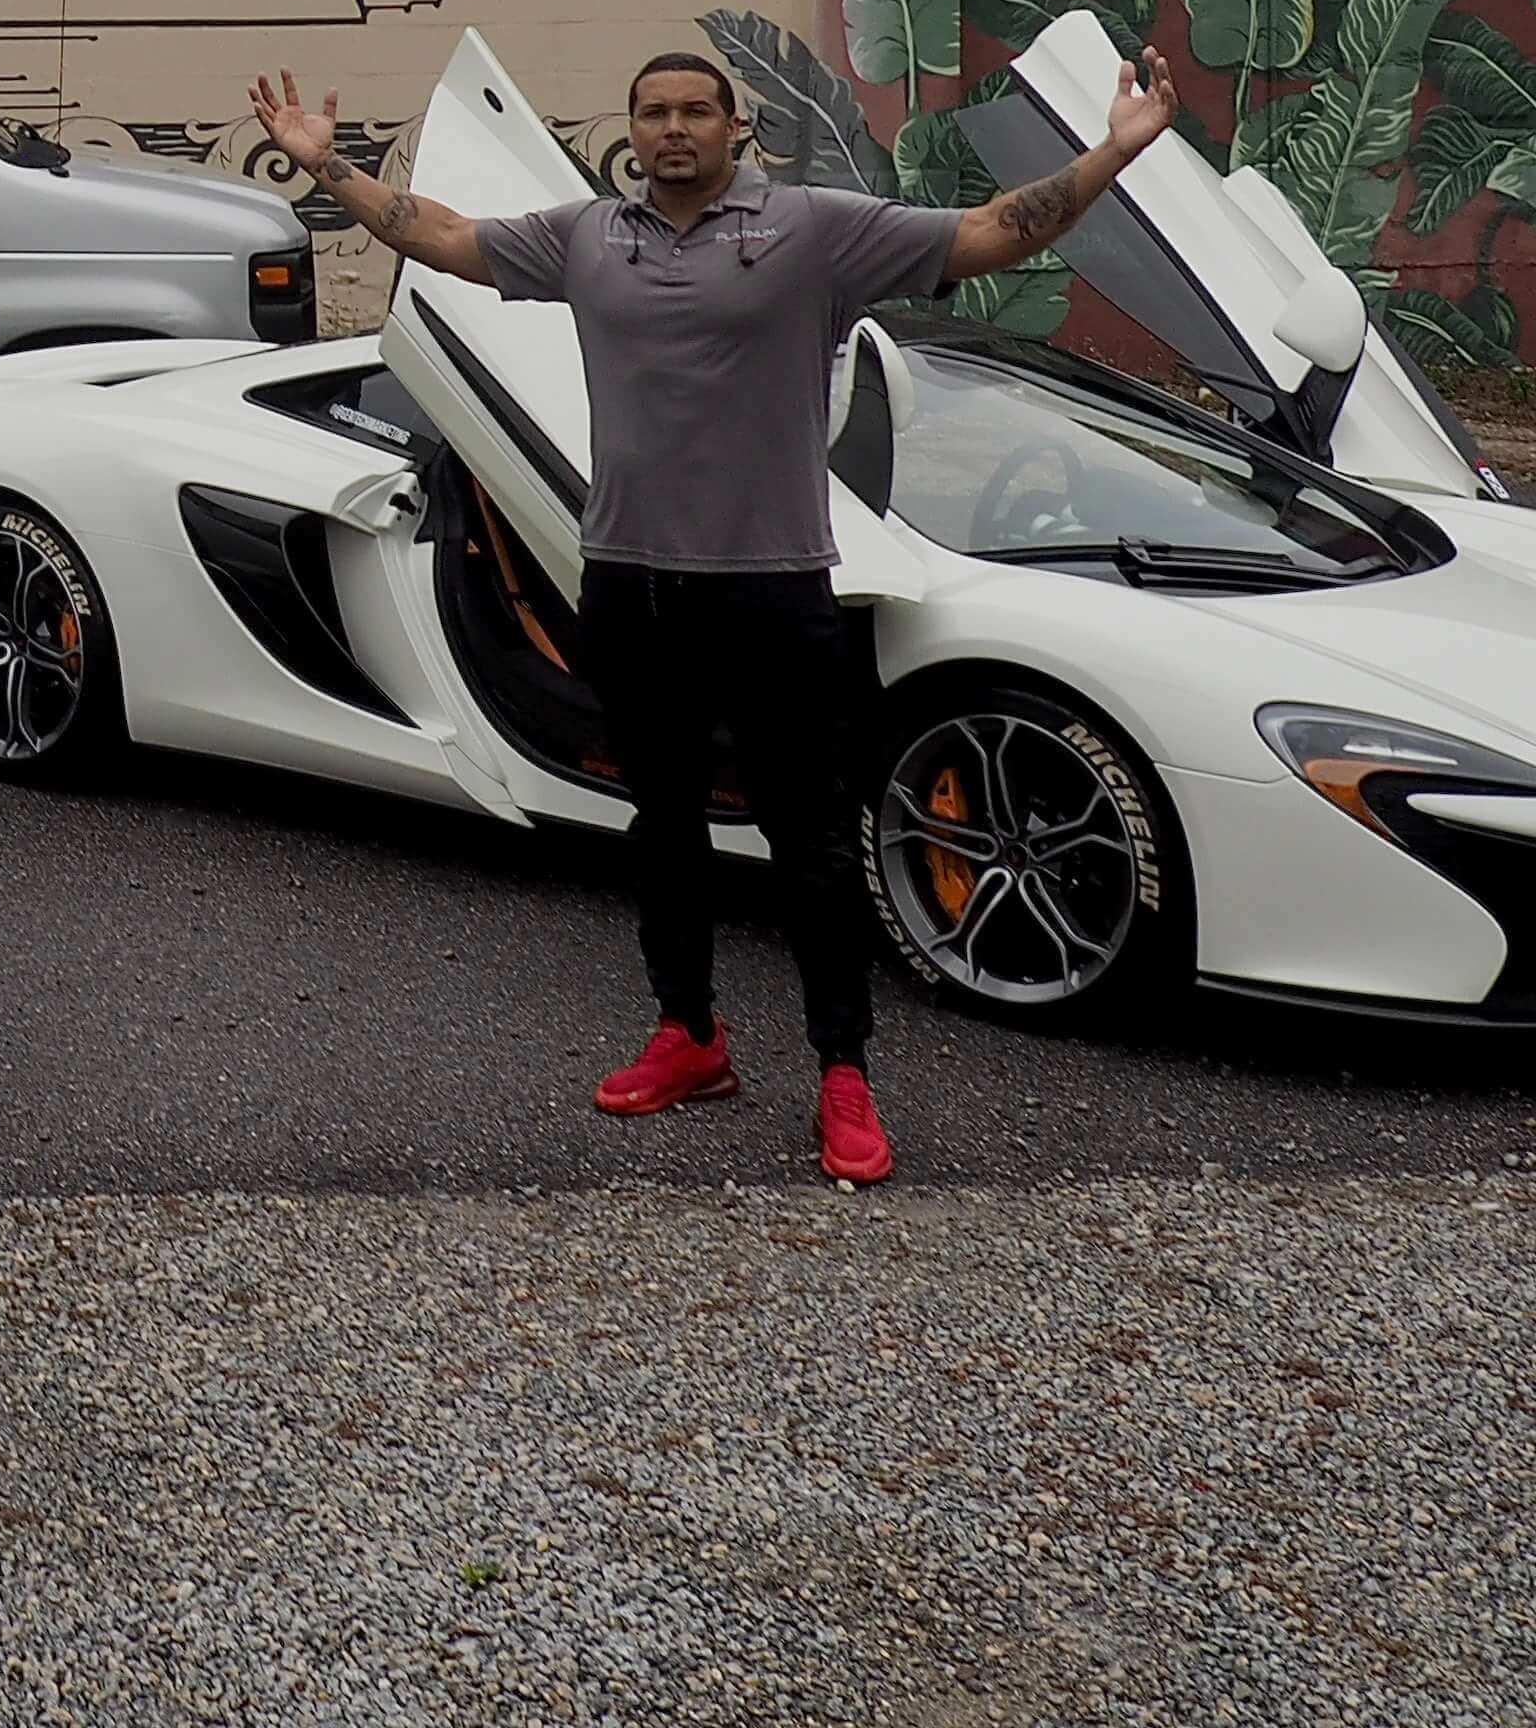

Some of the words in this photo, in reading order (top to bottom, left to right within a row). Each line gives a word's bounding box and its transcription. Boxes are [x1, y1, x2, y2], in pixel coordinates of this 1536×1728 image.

[1, 513, 92, 618] MICHELIN
[860, 804, 940, 985] MICHELIN
[1061, 722, 1160, 912] MICHELIN
